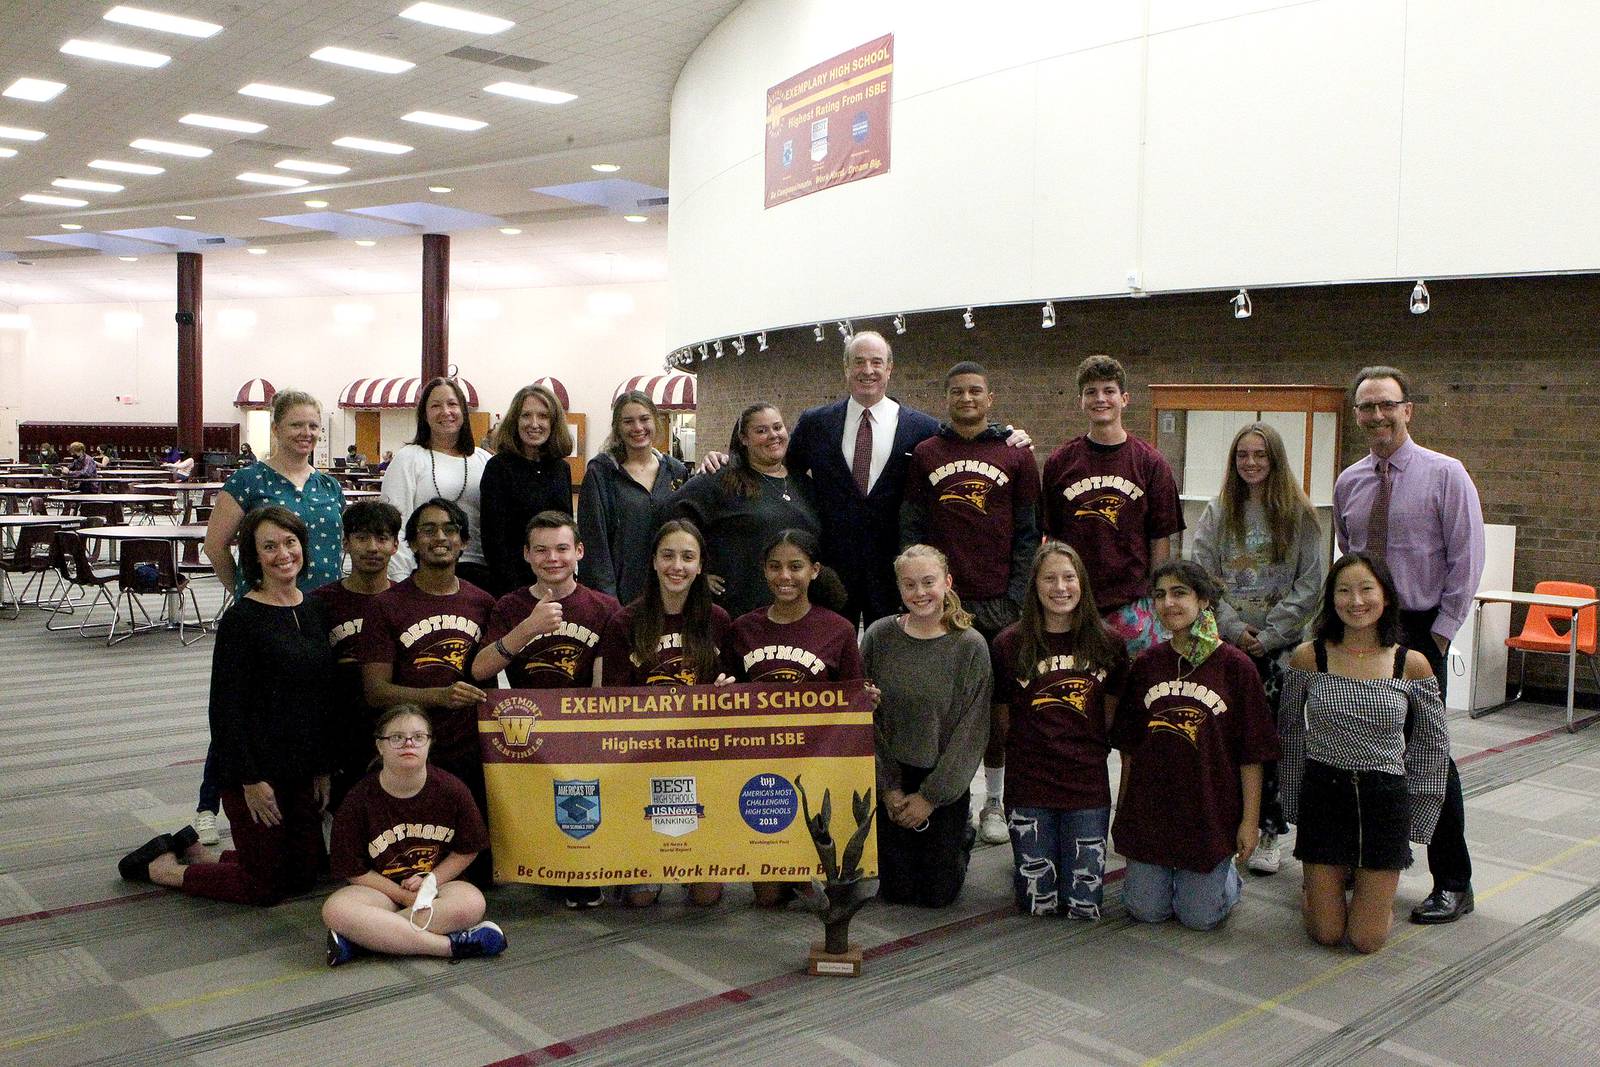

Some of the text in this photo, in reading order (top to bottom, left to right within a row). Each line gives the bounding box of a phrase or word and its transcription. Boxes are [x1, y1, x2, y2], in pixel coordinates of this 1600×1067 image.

[785, 71, 828, 100] EXEMPLARY
[830, 64, 850, 81] HIGH
[852, 47, 890, 72] SCHOOL
[816, 100, 840, 117] Rating
[842, 91, 863, 108] From
[865, 81, 886, 98] ISBE
[928, 460, 1010, 486] WESTMONT
[1063, 476, 1144, 501] WESTMONT
[744, 646, 826, 675] ESTMONT
[492, 696, 543, 718] WESTMONT
[560, 689, 848, 714] EXEMPLARY HIGH SCHOOL
[498, 716, 536, 746] W
[492, 737, 544, 758] SENTINELS
[601, 732, 806, 754] Highest Rating From ISBE
[558, 784, 596, 796] AMERICA'S TOP
[652, 780, 694, 793] BEST
[760, 776, 776, 788] wp
[654, 793, 694, 804] HIGH SCHOOLS
[746, 798, 790, 806] CHALLENGING
[759, 818, 778, 826] 2018
[518, 865, 534, 878] Be
[538, 866, 652, 880] Compassionate.
[662, 864, 703, 878] Work
[708, 864, 750, 876] Hard.
[760, 864, 810, 876] Dream
